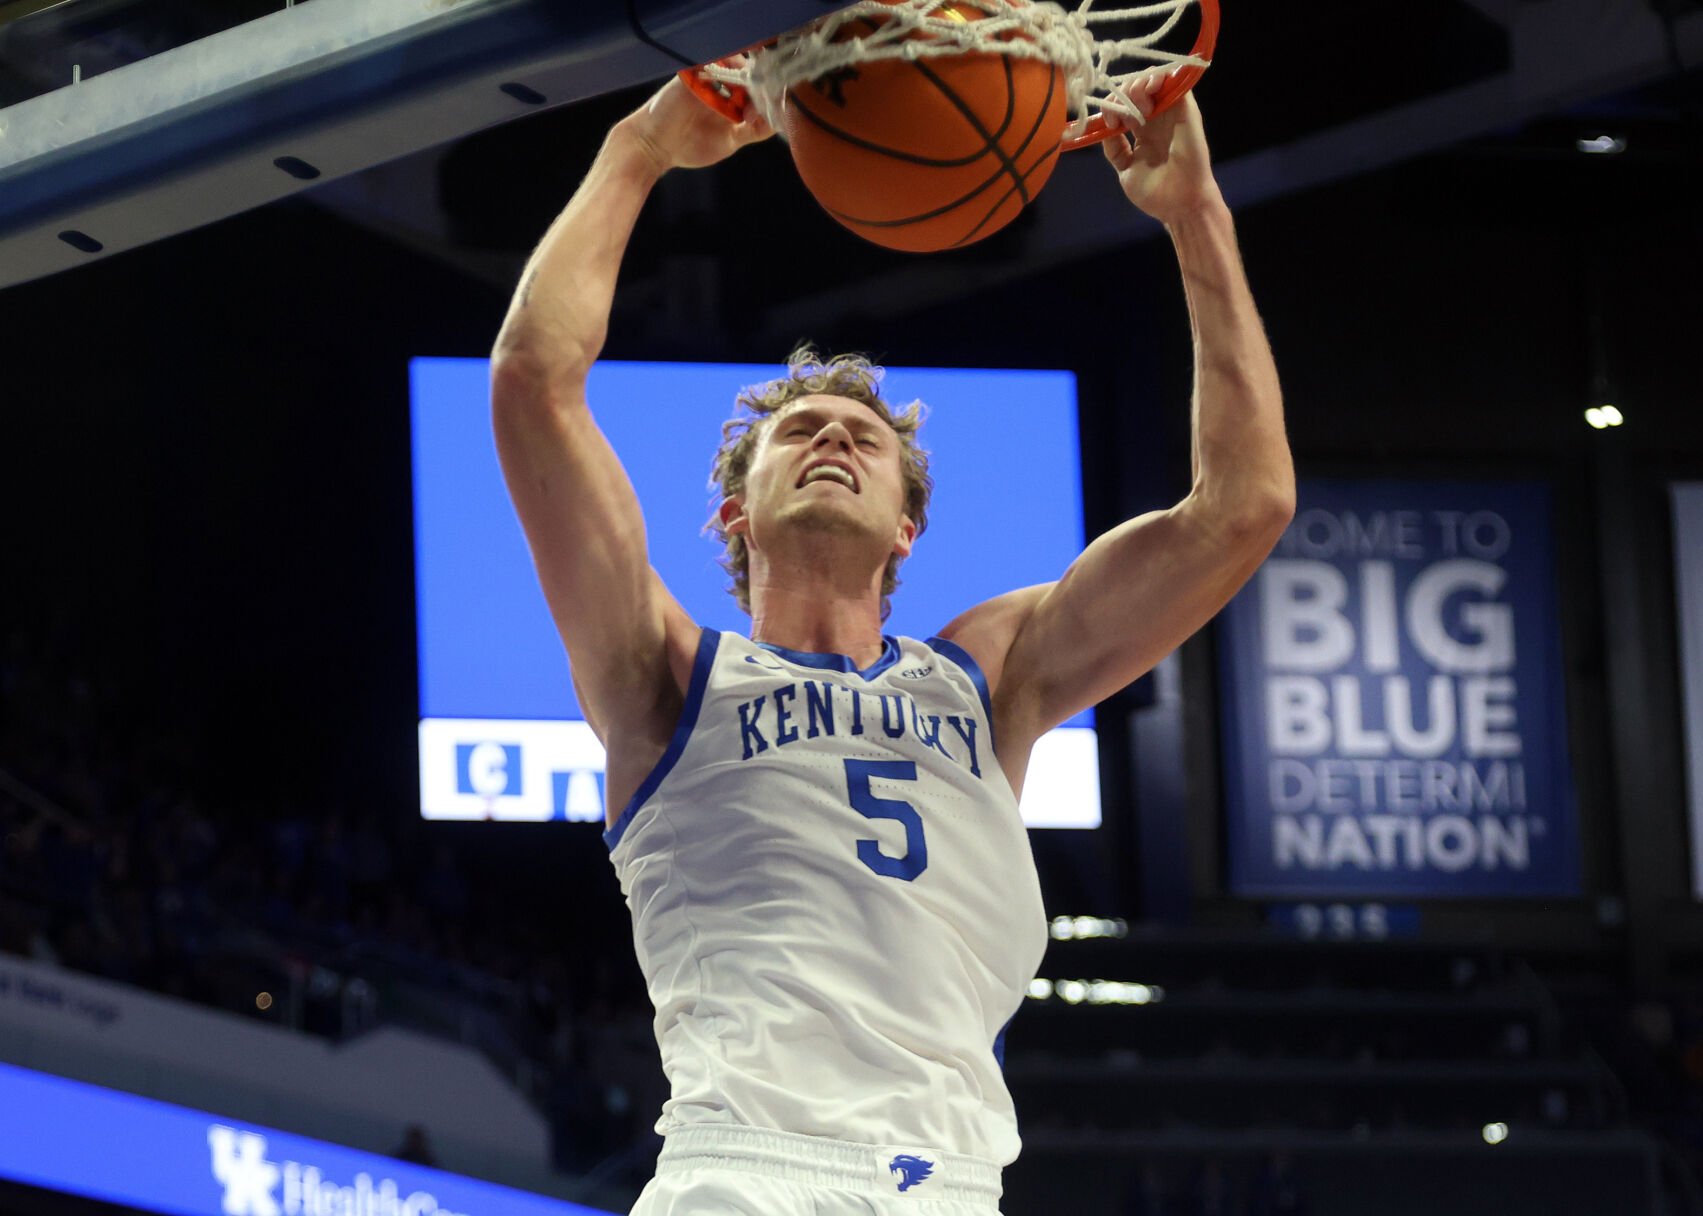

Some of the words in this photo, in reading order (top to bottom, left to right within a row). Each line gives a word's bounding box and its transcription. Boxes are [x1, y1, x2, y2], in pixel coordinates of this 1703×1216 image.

[1428, 509, 1512, 562] TO
[1261, 558, 1516, 675] BIG
[1268, 675, 1521, 758] BLUE
[843, 758, 928, 882] 5
[1267, 759, 1527, 815] DETERMI
[1273, 814, 1531, 873] NATION
